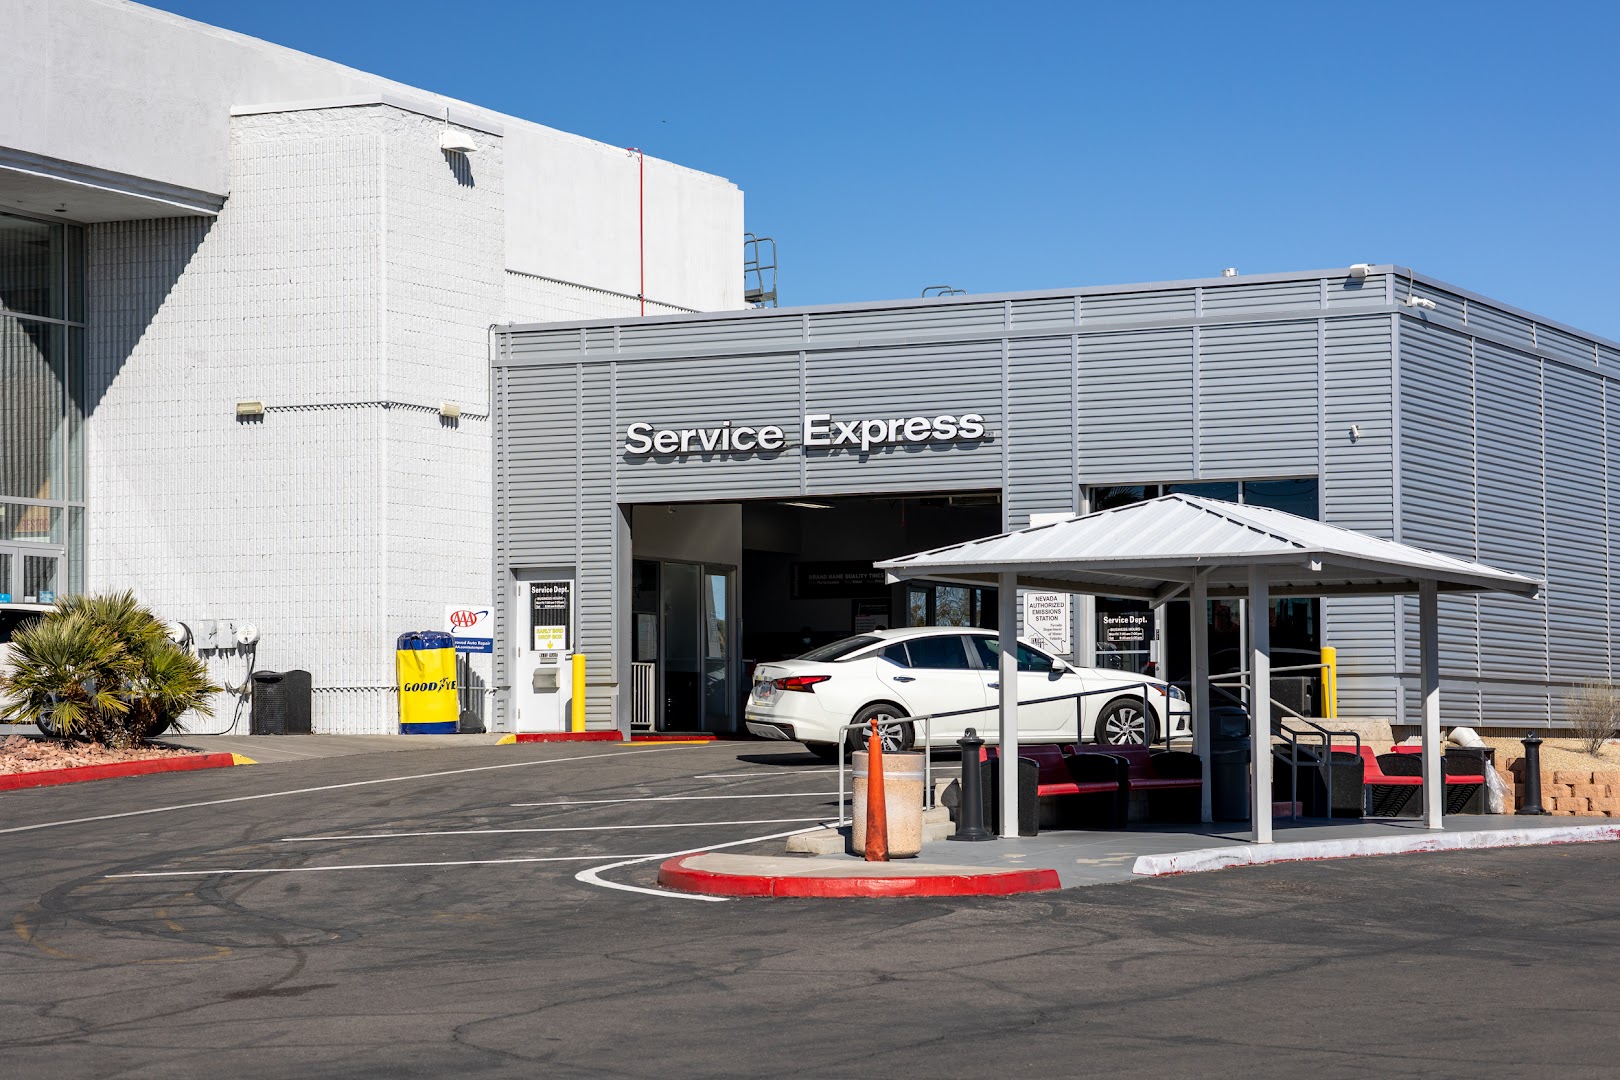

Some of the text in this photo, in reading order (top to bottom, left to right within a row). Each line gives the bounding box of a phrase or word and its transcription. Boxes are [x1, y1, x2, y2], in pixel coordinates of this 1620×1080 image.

[624, 413, 986, 454] Service Express
[531, 585, 570, 595] Service Dept.
[452, 610, 475, 627] AAA
[1103, 615, 1148, 625] Service Dept.
